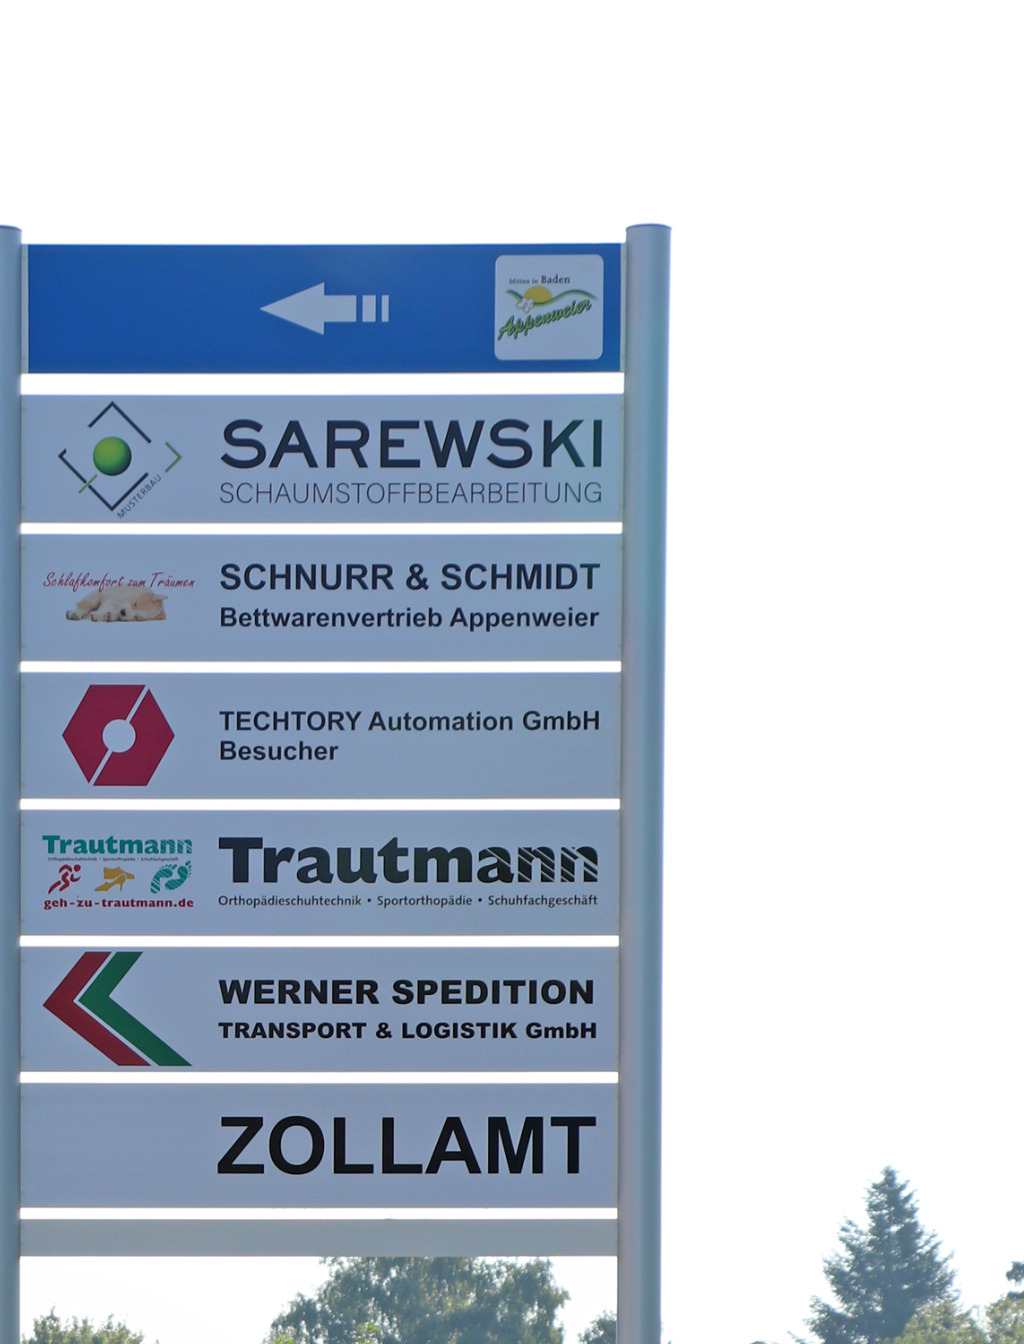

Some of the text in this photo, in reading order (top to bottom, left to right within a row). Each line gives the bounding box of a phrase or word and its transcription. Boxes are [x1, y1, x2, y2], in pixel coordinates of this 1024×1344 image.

[541, 274, 570, 284] Baden
[497, 298, 592, 341] Appenweier
[221, 419, 602, 469] SAREWSKI
[117, 474, 162, 519] MUSTERBAU
[220, 482, 601, 504] SCHAUMSTOFFBEARBEITUNG
[43, 571, 196, 592] Schlafkomfort zum Träumen
[220, 563, 600, 590] SCHNURR & SCHMIDT
[221, 607, 599, 632] Bettwarenvertrieb Appenweier
[219, 711, 599, 731] TECHTORY Automation GmbH
[220, 741, 338, 760] Besucher
[42, 835, 192, 854] Trautmann
[219, 837, 598, 884] Trautmann
[44, 898, 193, 910] geh-zu-trautmann.de
[218, 895, 361, 908] Orthopädieschuhtechnik
[377, 895, 472, 908] Sportorthopädie
[488, 895, 597, 908] Schuhfachgeschäft
[219, 980, 593, 1005] WERNER SPEDITION
[218, 1022, 596, 1039] TRANSPORT & LOGISTIK GmbH
[217, 1116, 596, 1175] ZOLLAMT
